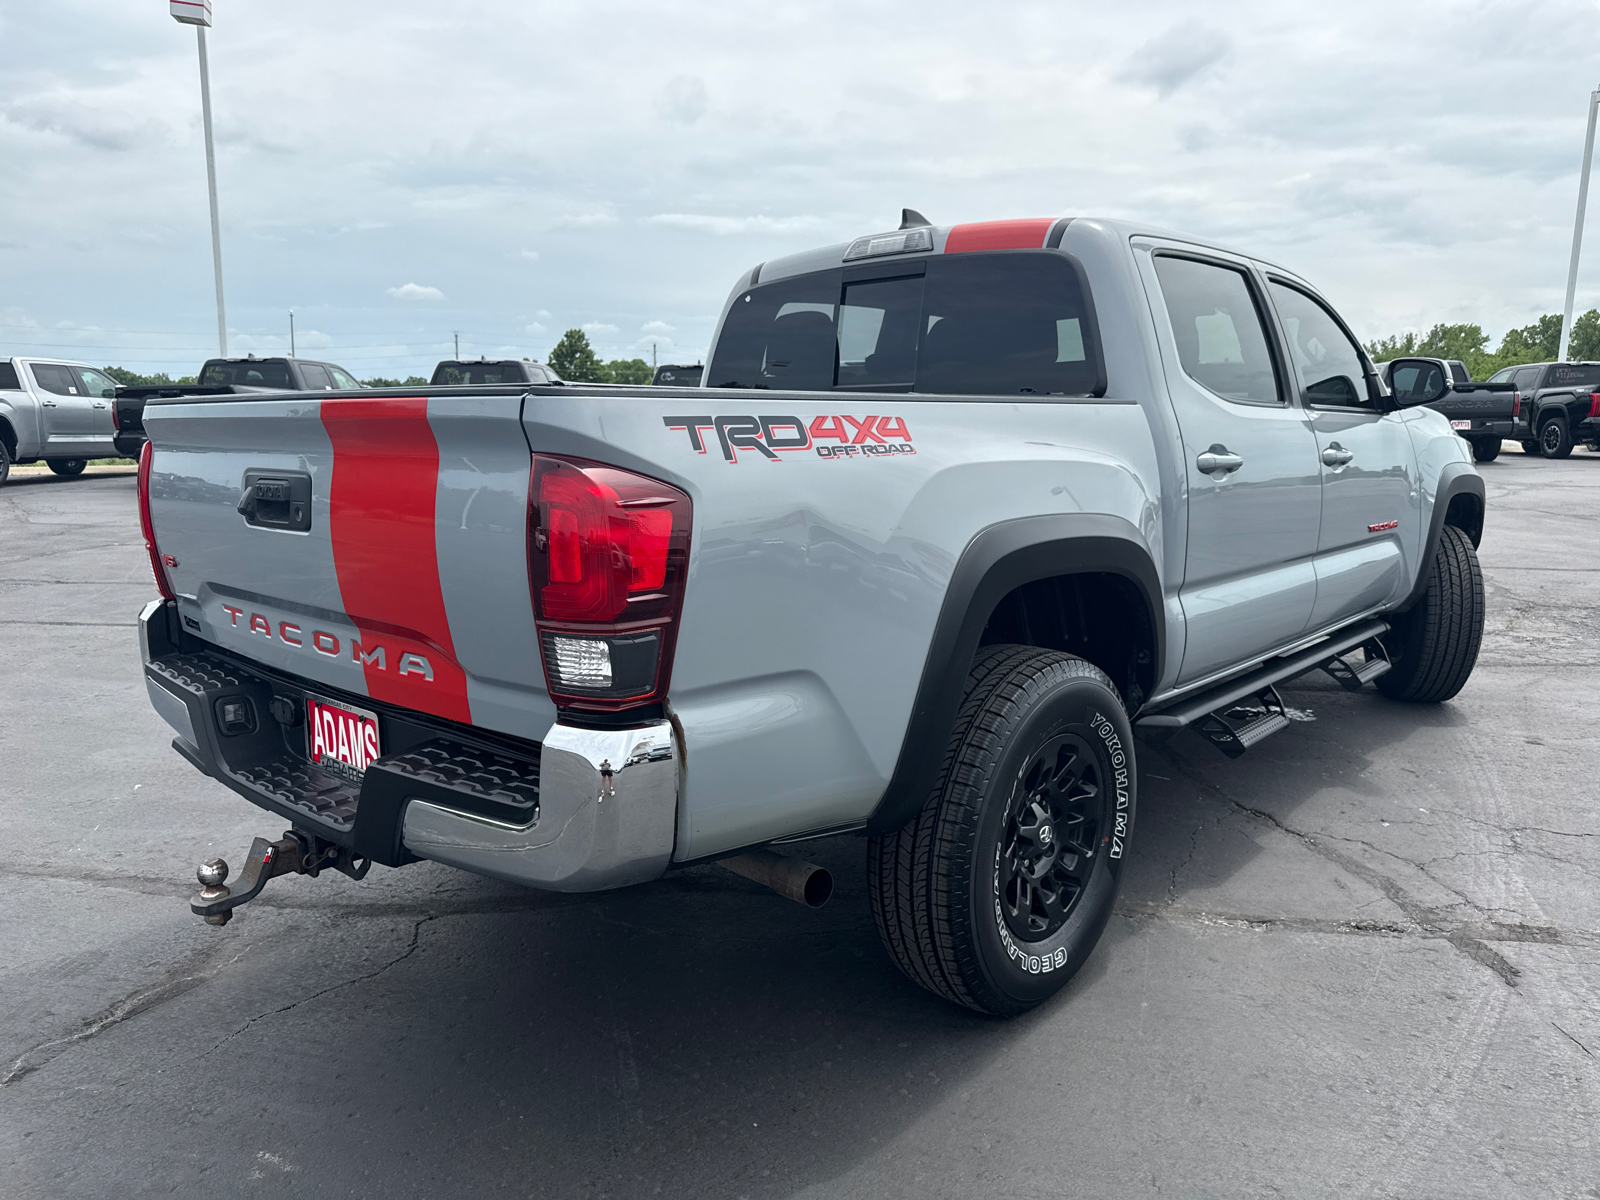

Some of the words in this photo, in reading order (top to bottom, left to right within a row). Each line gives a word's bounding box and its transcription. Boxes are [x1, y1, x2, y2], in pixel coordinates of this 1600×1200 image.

[662, 415, 813, 464] TRD
[816, 446, 860, 460] OFF
[861, 443, 918, 458] ROAD
[254, 484, 284, 499] TOYOTA
[1367, 519, 1399, 533] TACOMA
[221, 603, 434, 682] TACOMA
[314, 706, 378, 771] ADAMS
[1090, 711, 1130, 860] YOKOHAMA
[993, 841, 1068, 974] GEOLANDAR
